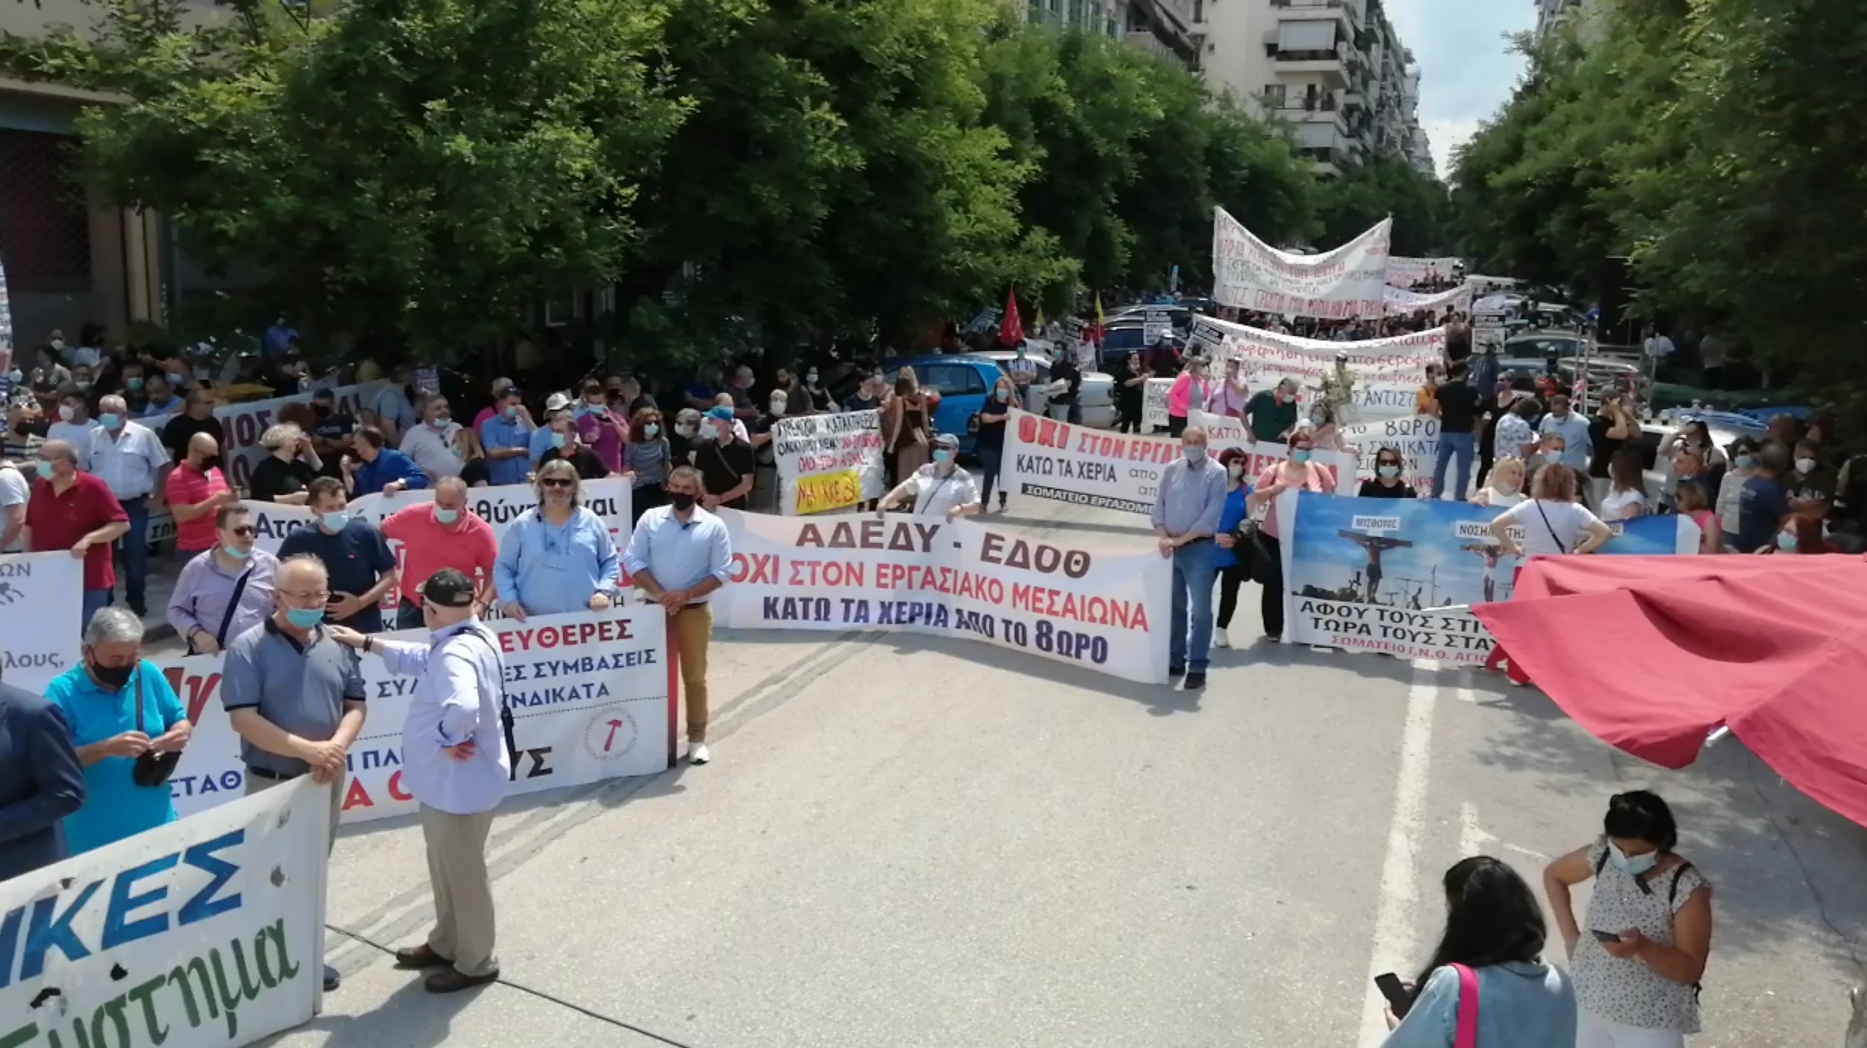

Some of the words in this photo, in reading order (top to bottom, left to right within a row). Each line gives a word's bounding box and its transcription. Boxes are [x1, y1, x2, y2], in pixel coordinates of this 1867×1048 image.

[1018, 415, 1070, 449] ΟΧΙ
[1077, 433, 1125, 459] ΣΤΟΝ
[1384, 419, 1437, 437] 8ΩΡΟ
[1016, 454, 1053, 475] ΚΑΤΩ
[1056, 458, 1074, 478] ΤΑ
[1077, 461, 1117, 483] ΧΕΡΙΑ
[1026, 485, 1089, 504] ΣΩΜΑΤΕΙΟ
[795, 521, 940, 553] ΑΔΕΔΥ
[980, 532, 1091, 578] ΕΔΟΘ
[730, 552, 780, 584] ΟΧΙ
[788, 560, 864, 588] ΣΤΟΝ
[876, 563, 1004, 605] ΕΡΓΑΣΙΑΚΟ
[1012, 583, 1149, 632] ΜΕΣΑΙΩΝΑ
[763, 596, 831, 621] ΚΑΤΩ
[840, 598, 870, 623] ΤΑ
[878, 600, 949, 628] ΧΕΡΙΑ
[955, 608, 995, 639] ΑΠΟ
[1001, 618, 1027, 647] ΤΟ
[1035, 620, 1108, 664] 8ΩΡΟ
[1300, 600, 1369, 620] ΑΦΟΥ
[1376, 608, 1434, 630] ΤΟΥΣ
[1311, 617, 1372, 636] ΤΩΡΑ
[1379, 625, 1437, 645] ΤΟΥΣ
[1331, 635, 1405, 653] ΣΩΜΑΤΕΙΟ
[533, 648, 657, 679] ΣΥΜΒΑΣΕΙΣ
